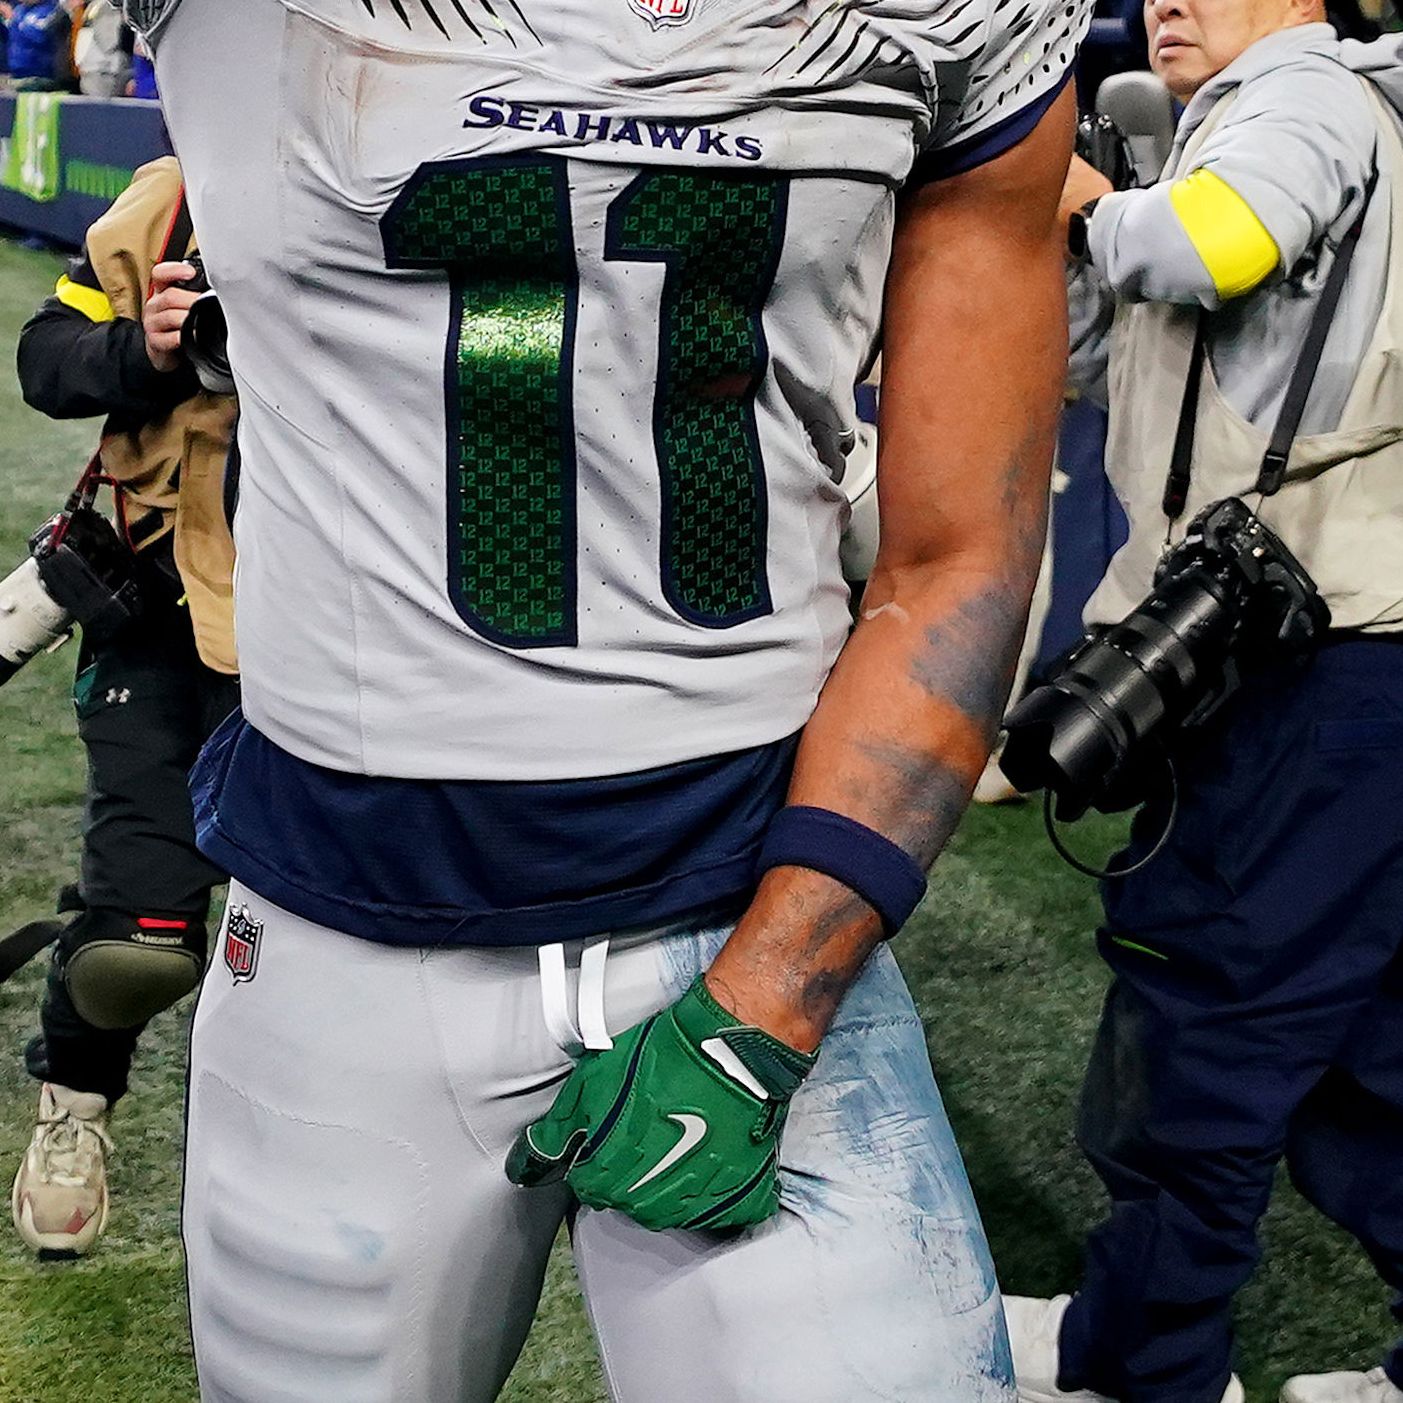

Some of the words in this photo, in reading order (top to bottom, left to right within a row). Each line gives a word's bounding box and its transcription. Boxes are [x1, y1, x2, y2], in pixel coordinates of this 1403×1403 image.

[462, 96, 764, 162] SEAHAWKS
[379, 154, 792, 649] 11
[226, 933, 249, 971] NFL
